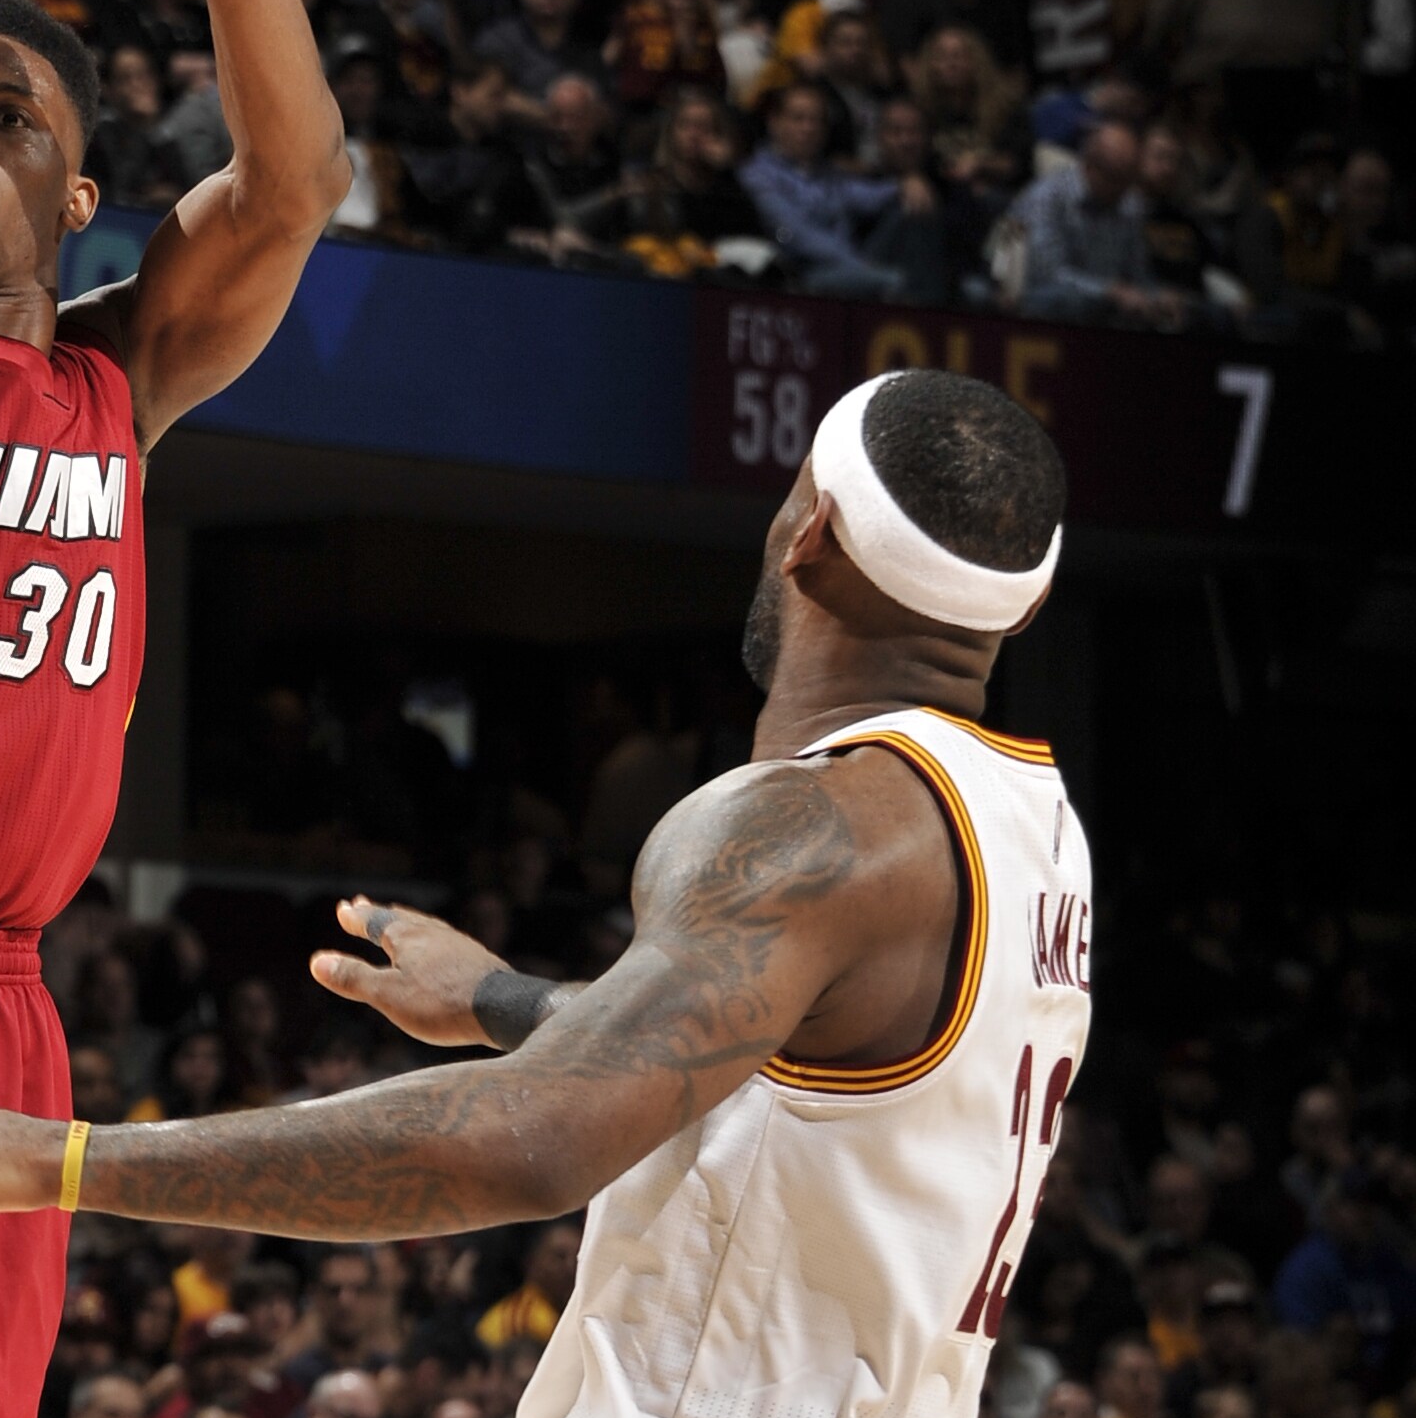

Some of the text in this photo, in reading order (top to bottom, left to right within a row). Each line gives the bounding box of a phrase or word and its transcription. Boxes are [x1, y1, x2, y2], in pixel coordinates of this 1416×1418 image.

[727, 303, 822, 371] FG%
[731, 369, 812, 470] 58
[1218, 364, 1275, 517] 7
